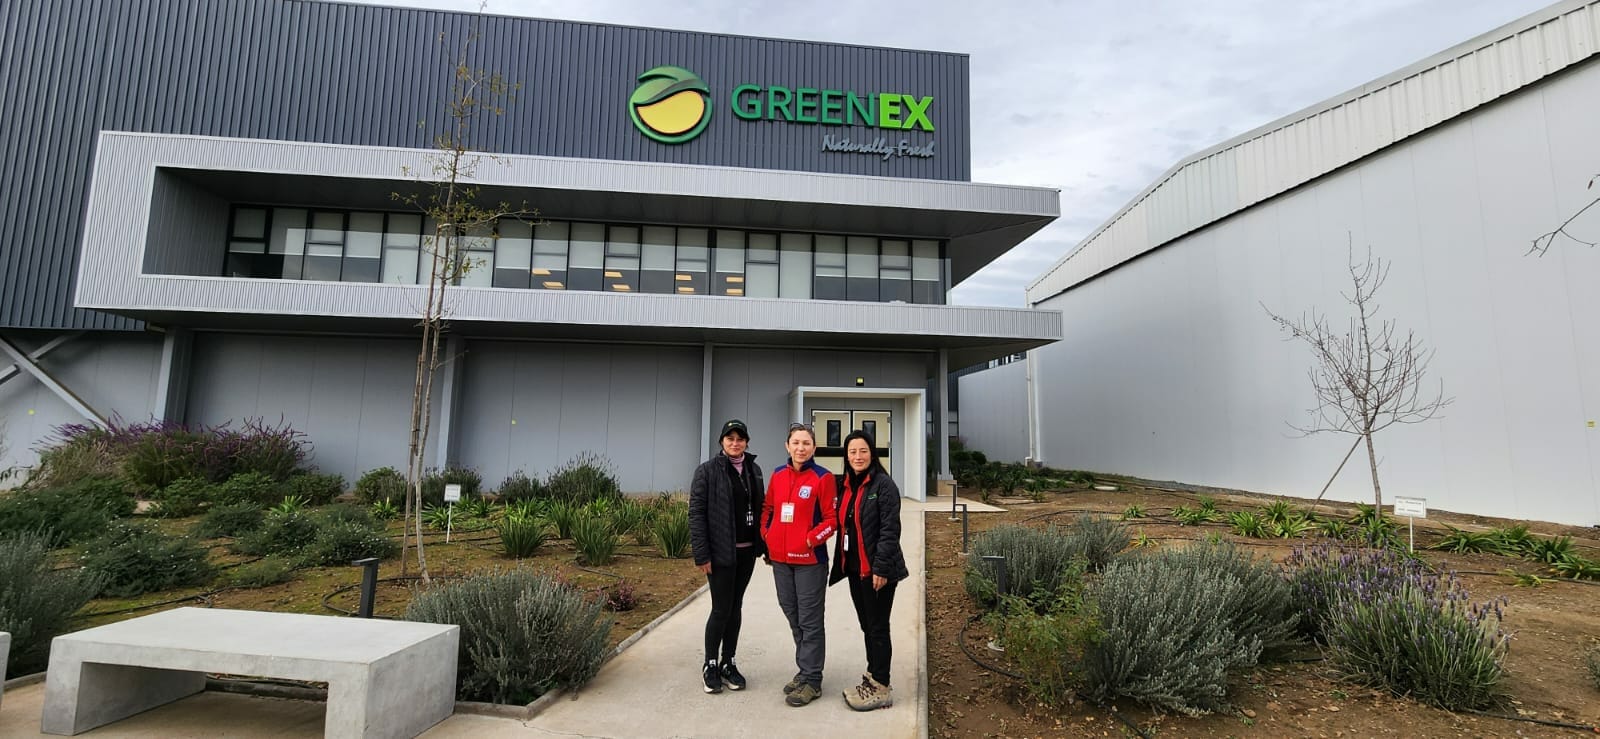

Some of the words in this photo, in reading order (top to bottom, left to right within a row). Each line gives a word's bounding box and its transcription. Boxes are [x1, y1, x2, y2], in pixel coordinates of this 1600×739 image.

[731, 83, 935, 132] GREENEX
[821, 134, 895, 160] Naturally
[897, 139, 935, 157] Fresh
